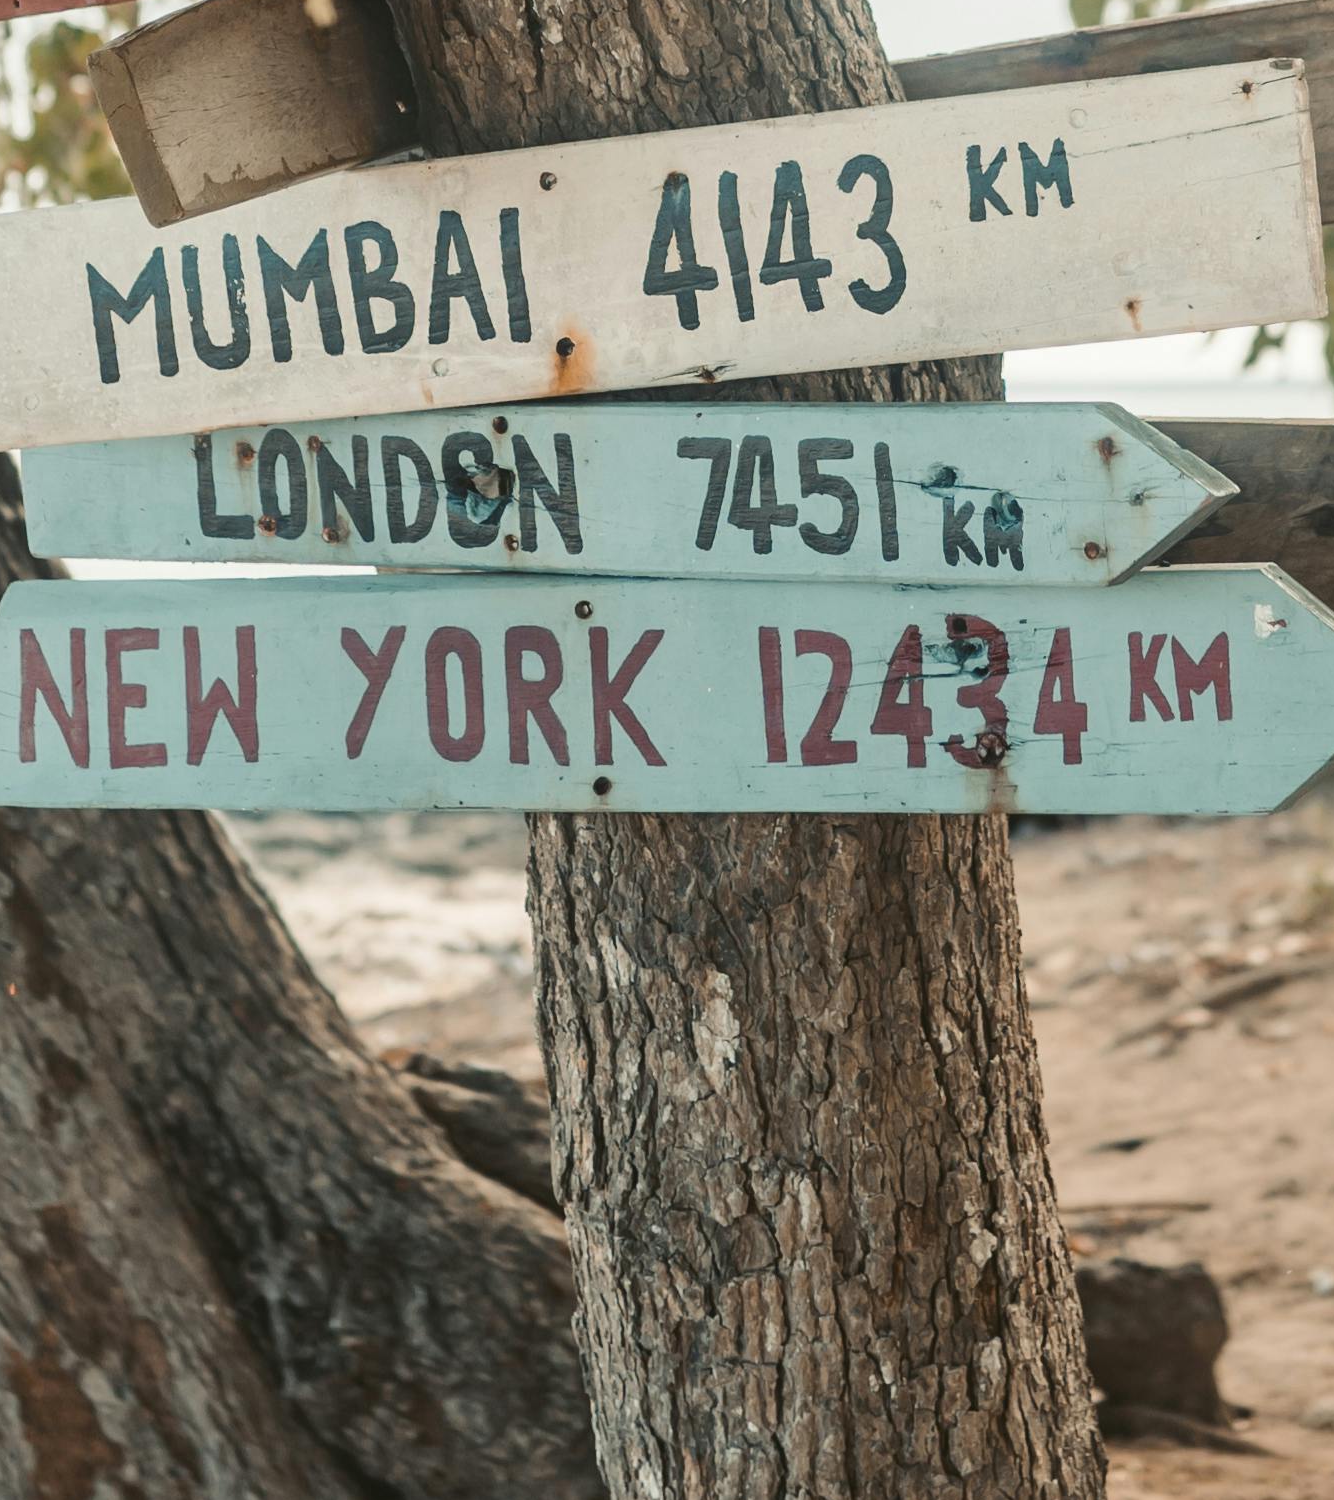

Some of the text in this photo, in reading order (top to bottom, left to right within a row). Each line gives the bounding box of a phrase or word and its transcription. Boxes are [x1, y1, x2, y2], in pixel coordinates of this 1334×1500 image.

[87, 137, 1075, 384] MUMBAI 4143 KM
[194, 428, 1025, 571] LONDON 7451 KM
[19, 613, 1234, 769] NEW YORK 12434 KM
